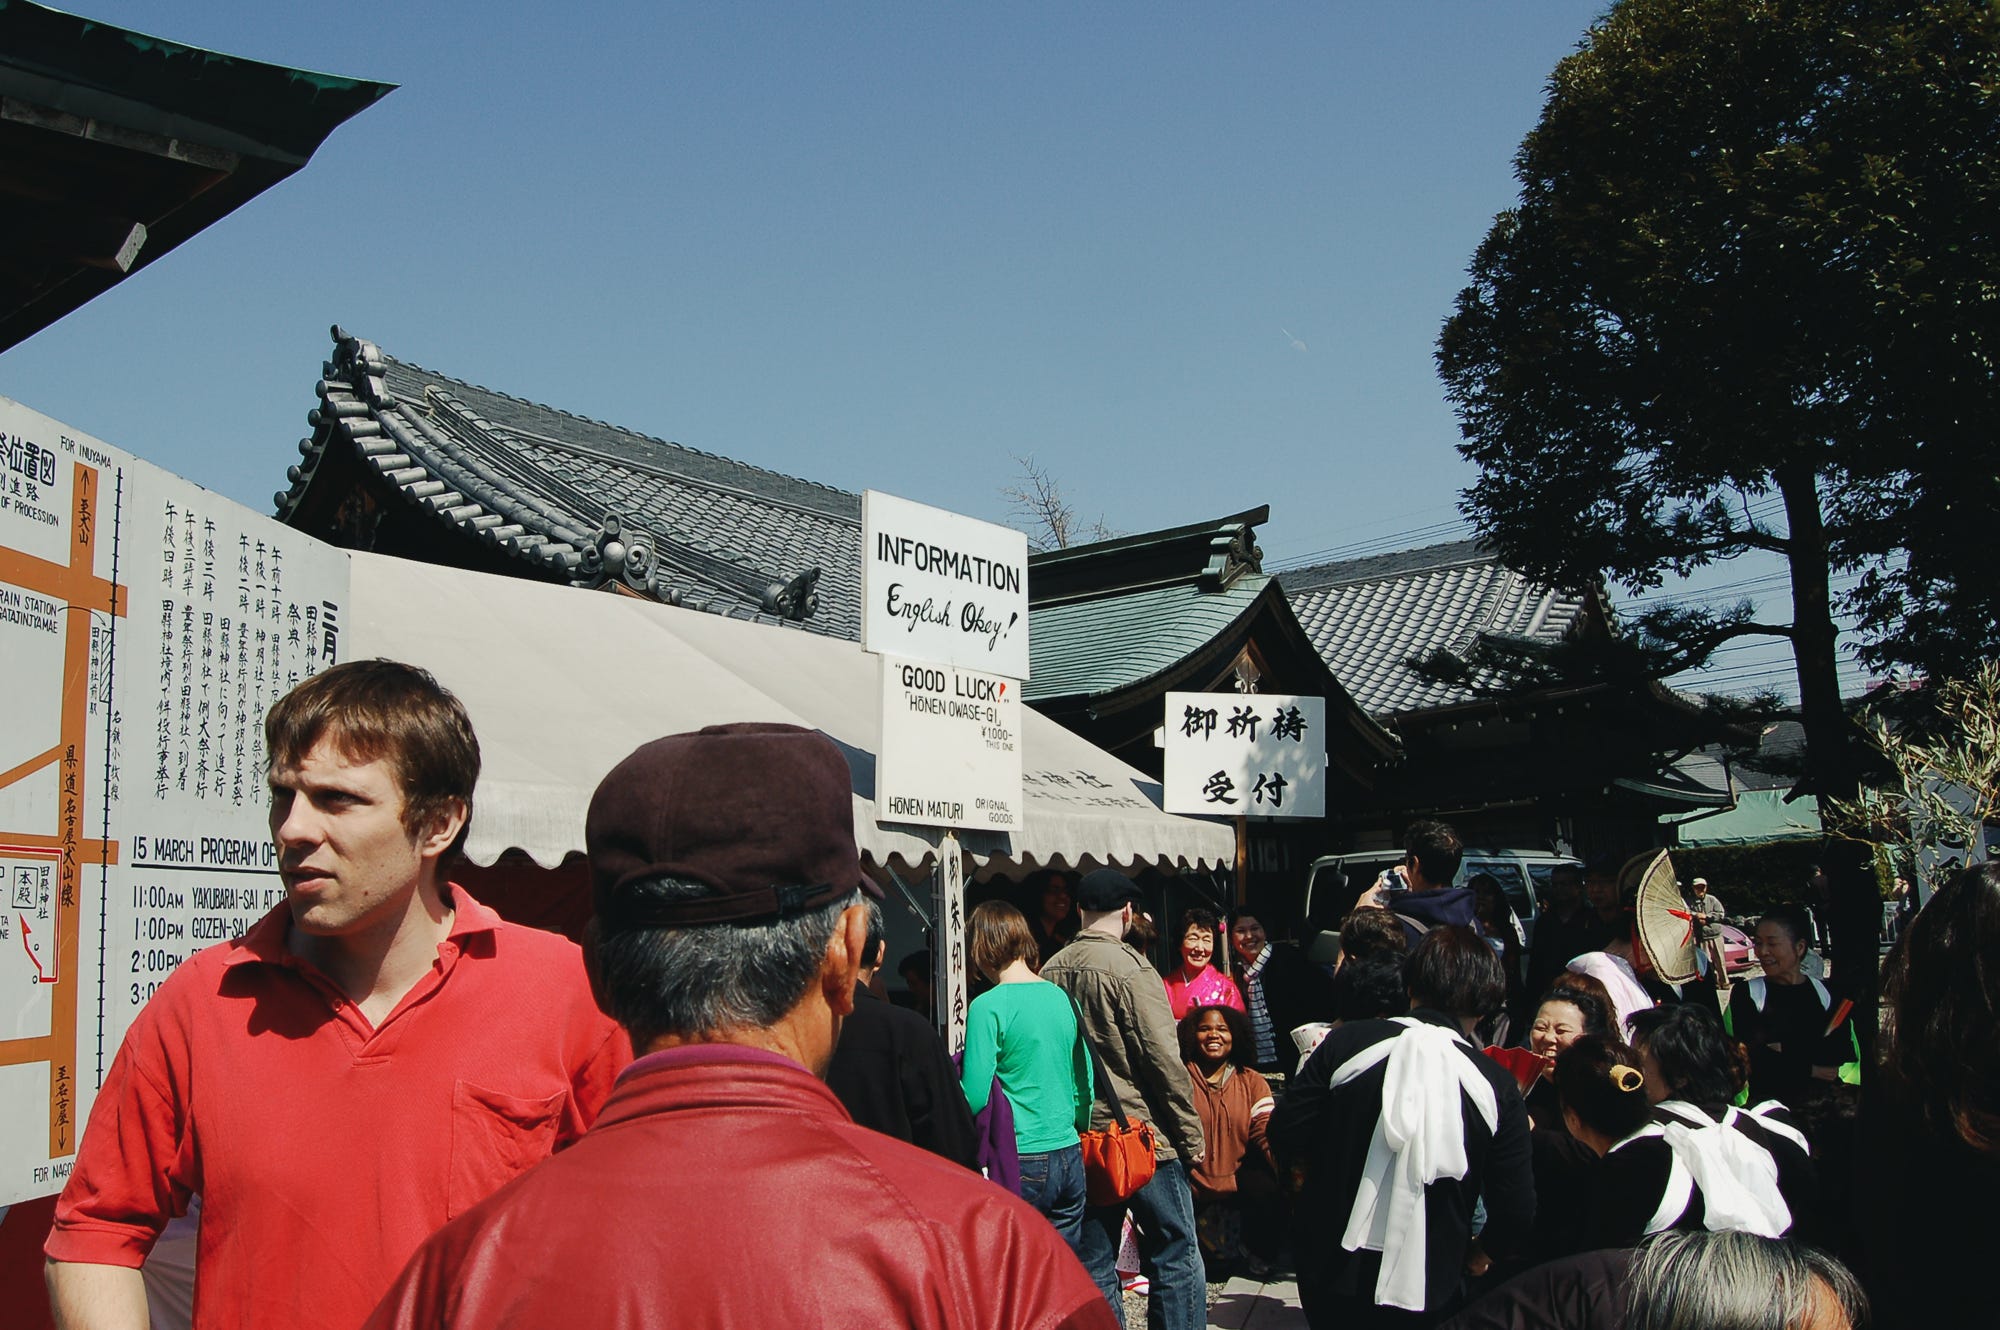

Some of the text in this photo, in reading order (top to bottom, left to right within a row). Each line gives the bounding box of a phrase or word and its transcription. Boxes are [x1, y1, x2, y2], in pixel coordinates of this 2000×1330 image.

[61, 435, 112, 470] FOR INUYAMA
[1, 496, 59, 527] OF PROCESSION
[78, 500, 91, 546] 至犬山
[878, 532, 1020, 594] INFORMATION
[24, 596, 57, 617] STATION
[886, 583, 1018, 652] English Okey!
[985, 739, 1014, 751] THIS ONE
[1203, 770, 1288, 808] 受付
[927, 801, 964, 820] MATURI
[975, 797, 1010, 812] ORIGNAL
[133, 836, 147, 860] 15
[154, 838, 194, 863] MARCH
[200, 837, 258, 866] PROGRAM
[16, 870, 32, 905] 本殿
[133, 885, 184, 909] 11:00AM
[192, 887, 258, 910] YAKUBARAI-SAI
[263, 889, 273, 910] AT
[135, 917, 248, 940] 1:00PM GOZEN-SAI
[131, 949, 182, 973] 2:00PM
[130, 981, 163, 1005] 3:0
[55, 1065, 70, 1127] 至名古屋
[33, 1167, 49, 1184] FOR
